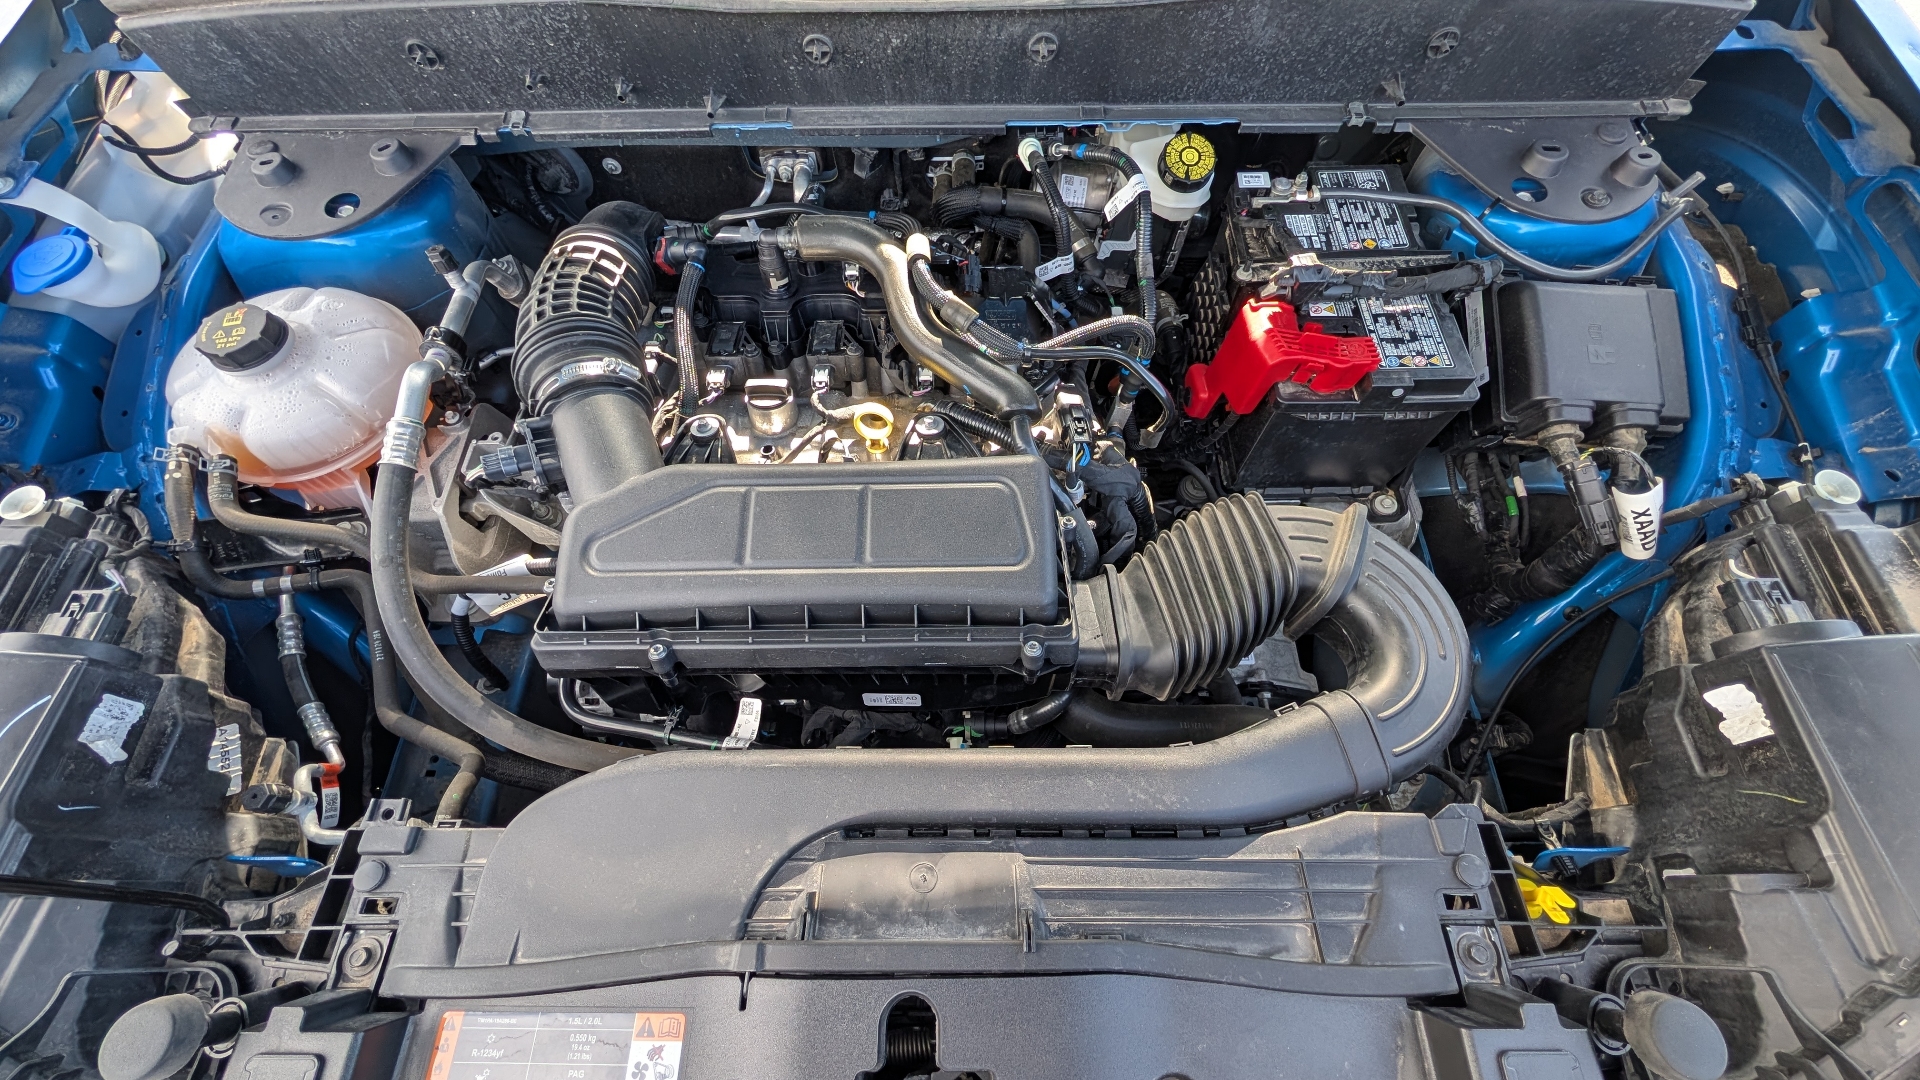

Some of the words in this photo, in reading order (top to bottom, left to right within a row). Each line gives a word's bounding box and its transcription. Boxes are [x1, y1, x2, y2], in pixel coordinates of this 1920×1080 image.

[1630, 507, 1657, 551] XAAD
[568, 1017, 583, 1025] 1.5L
[588, 1017, 603, 1025] 2.0L
[569, 1033, 588, 1042] 0.550
[588, 1034, 597, 1044] kg
[471, 1048, 505, 1060] R-1234yf
[567, 1069, 585, 1079] PAG
